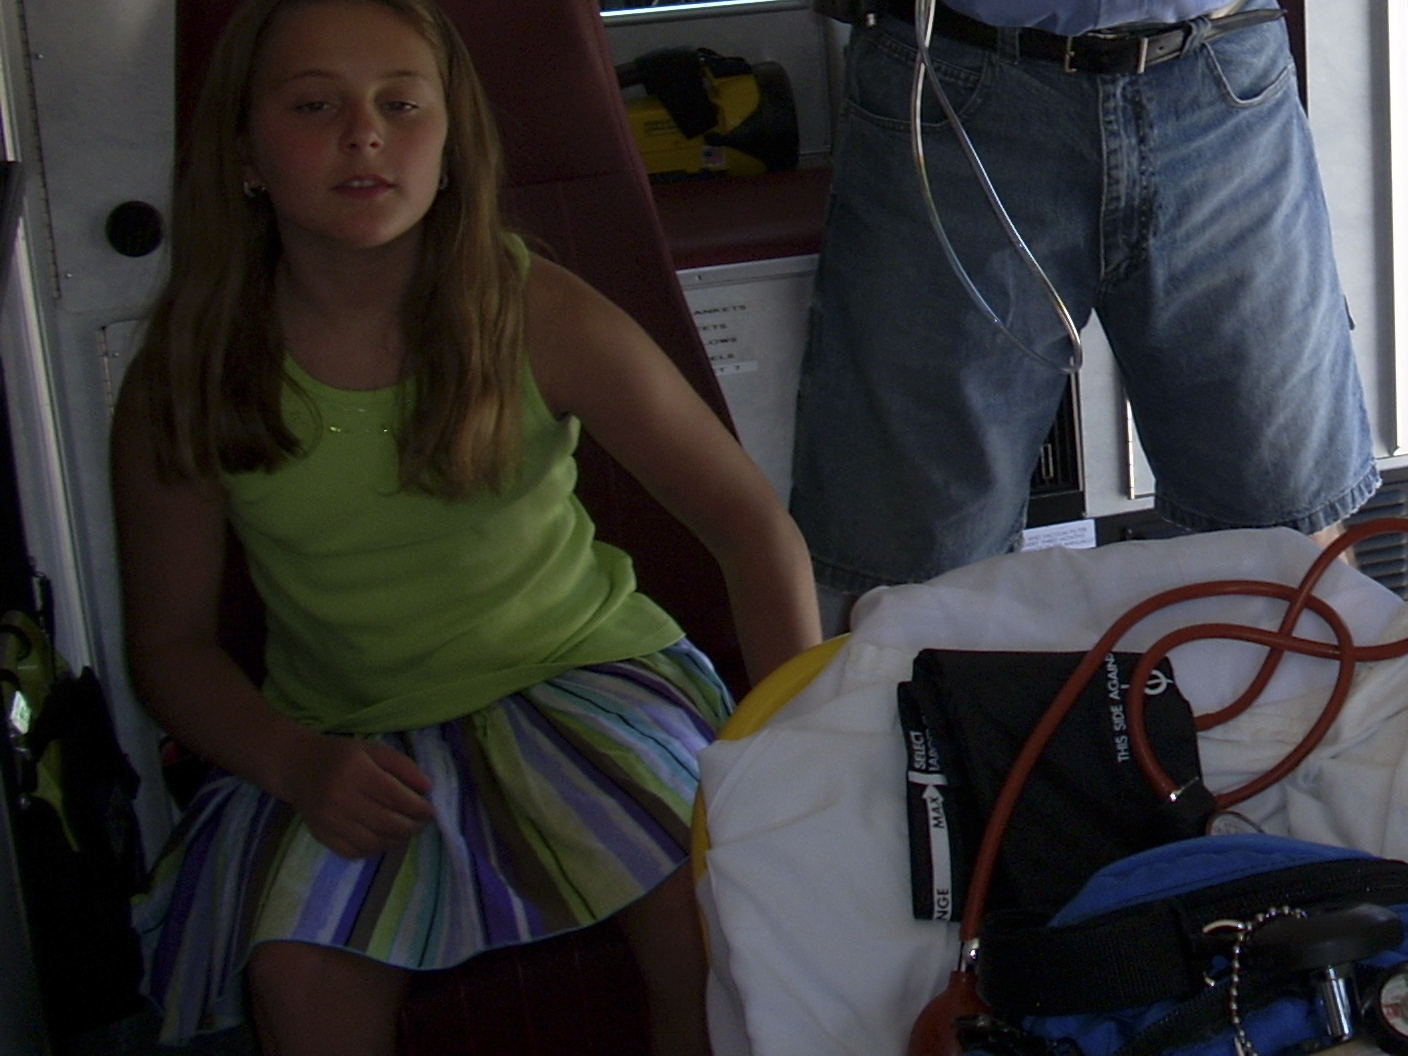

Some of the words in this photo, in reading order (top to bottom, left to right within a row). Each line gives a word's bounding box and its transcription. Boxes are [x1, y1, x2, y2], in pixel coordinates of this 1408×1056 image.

[694, 304, 747, 315] ANKETS
[1110, 704, 1127, 732] SIDE
[909, 730, 927, 771] SELECT
[1114, 734, 1131, 763] THIS
[930, 796, 946, 829] MAX
[936, 888, 950, 922] NGE
